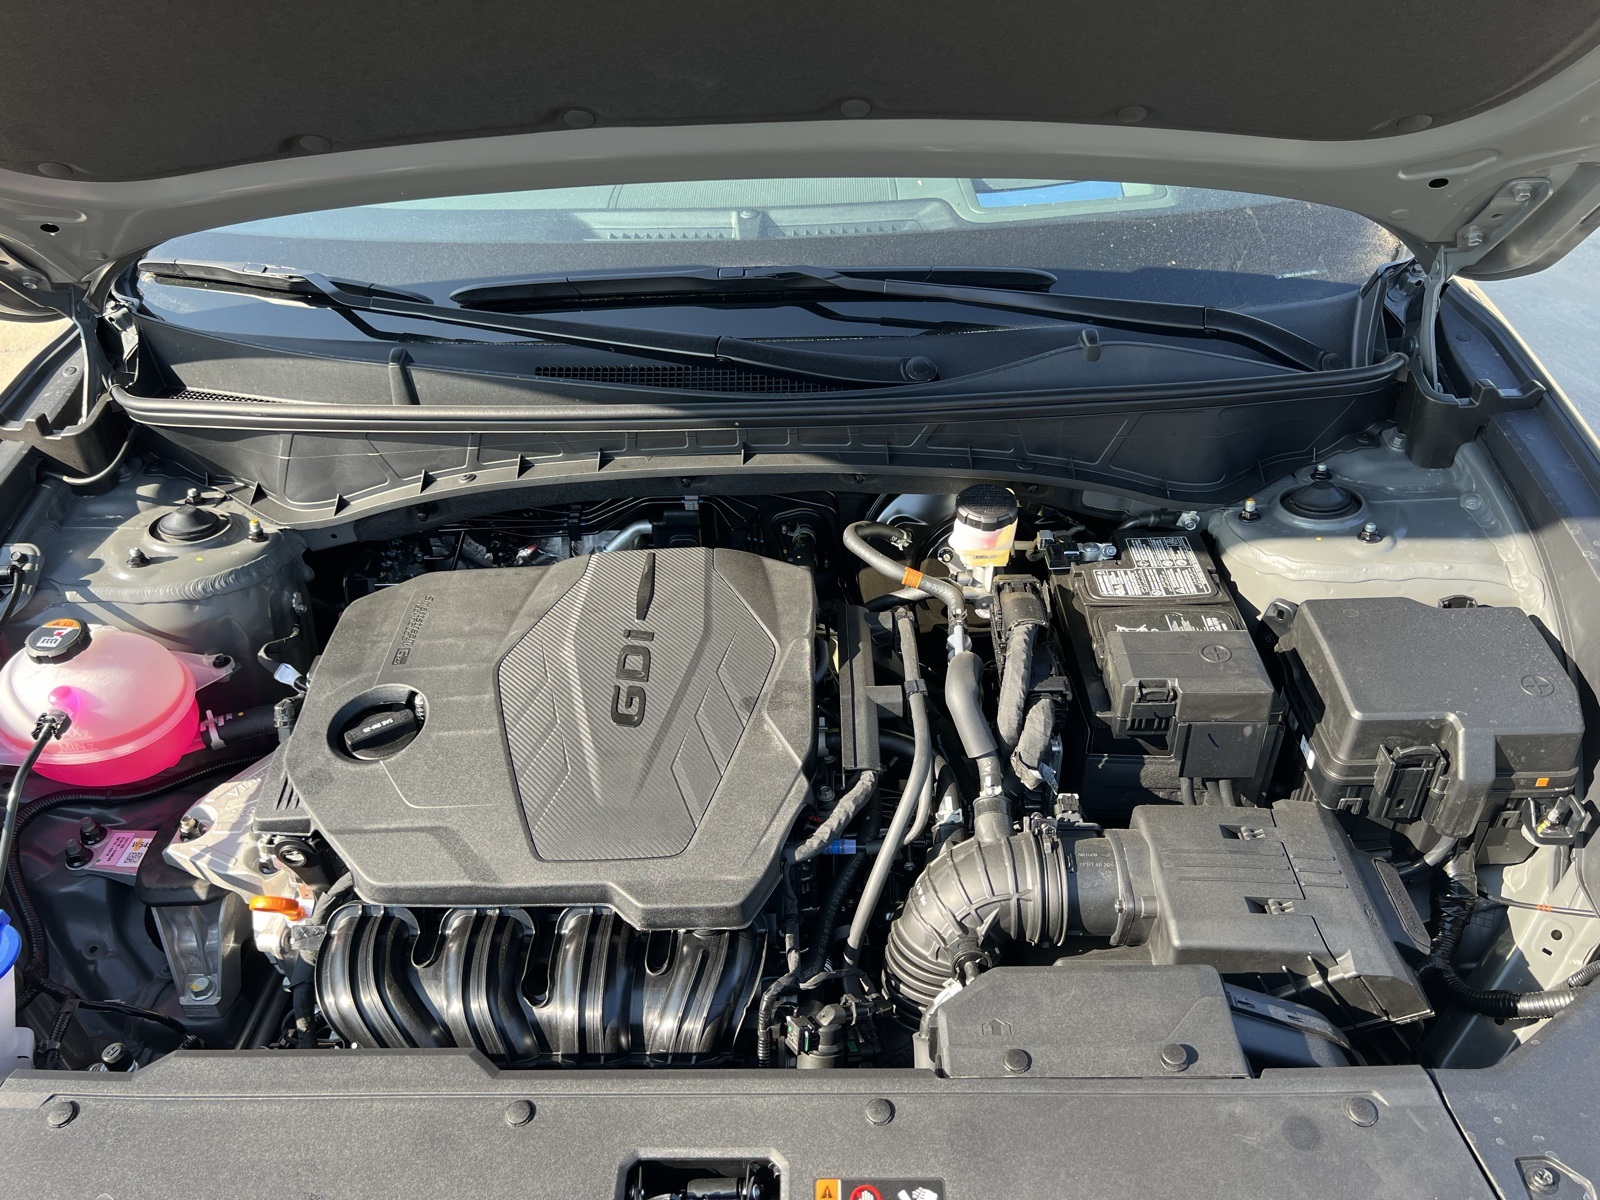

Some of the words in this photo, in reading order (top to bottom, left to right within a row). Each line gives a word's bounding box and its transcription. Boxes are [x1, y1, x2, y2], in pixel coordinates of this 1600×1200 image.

[405, 595, 434, 647] Smartstream
[381, 718, 393, 726] SAE
[58, 741, 86, 752] MIN
